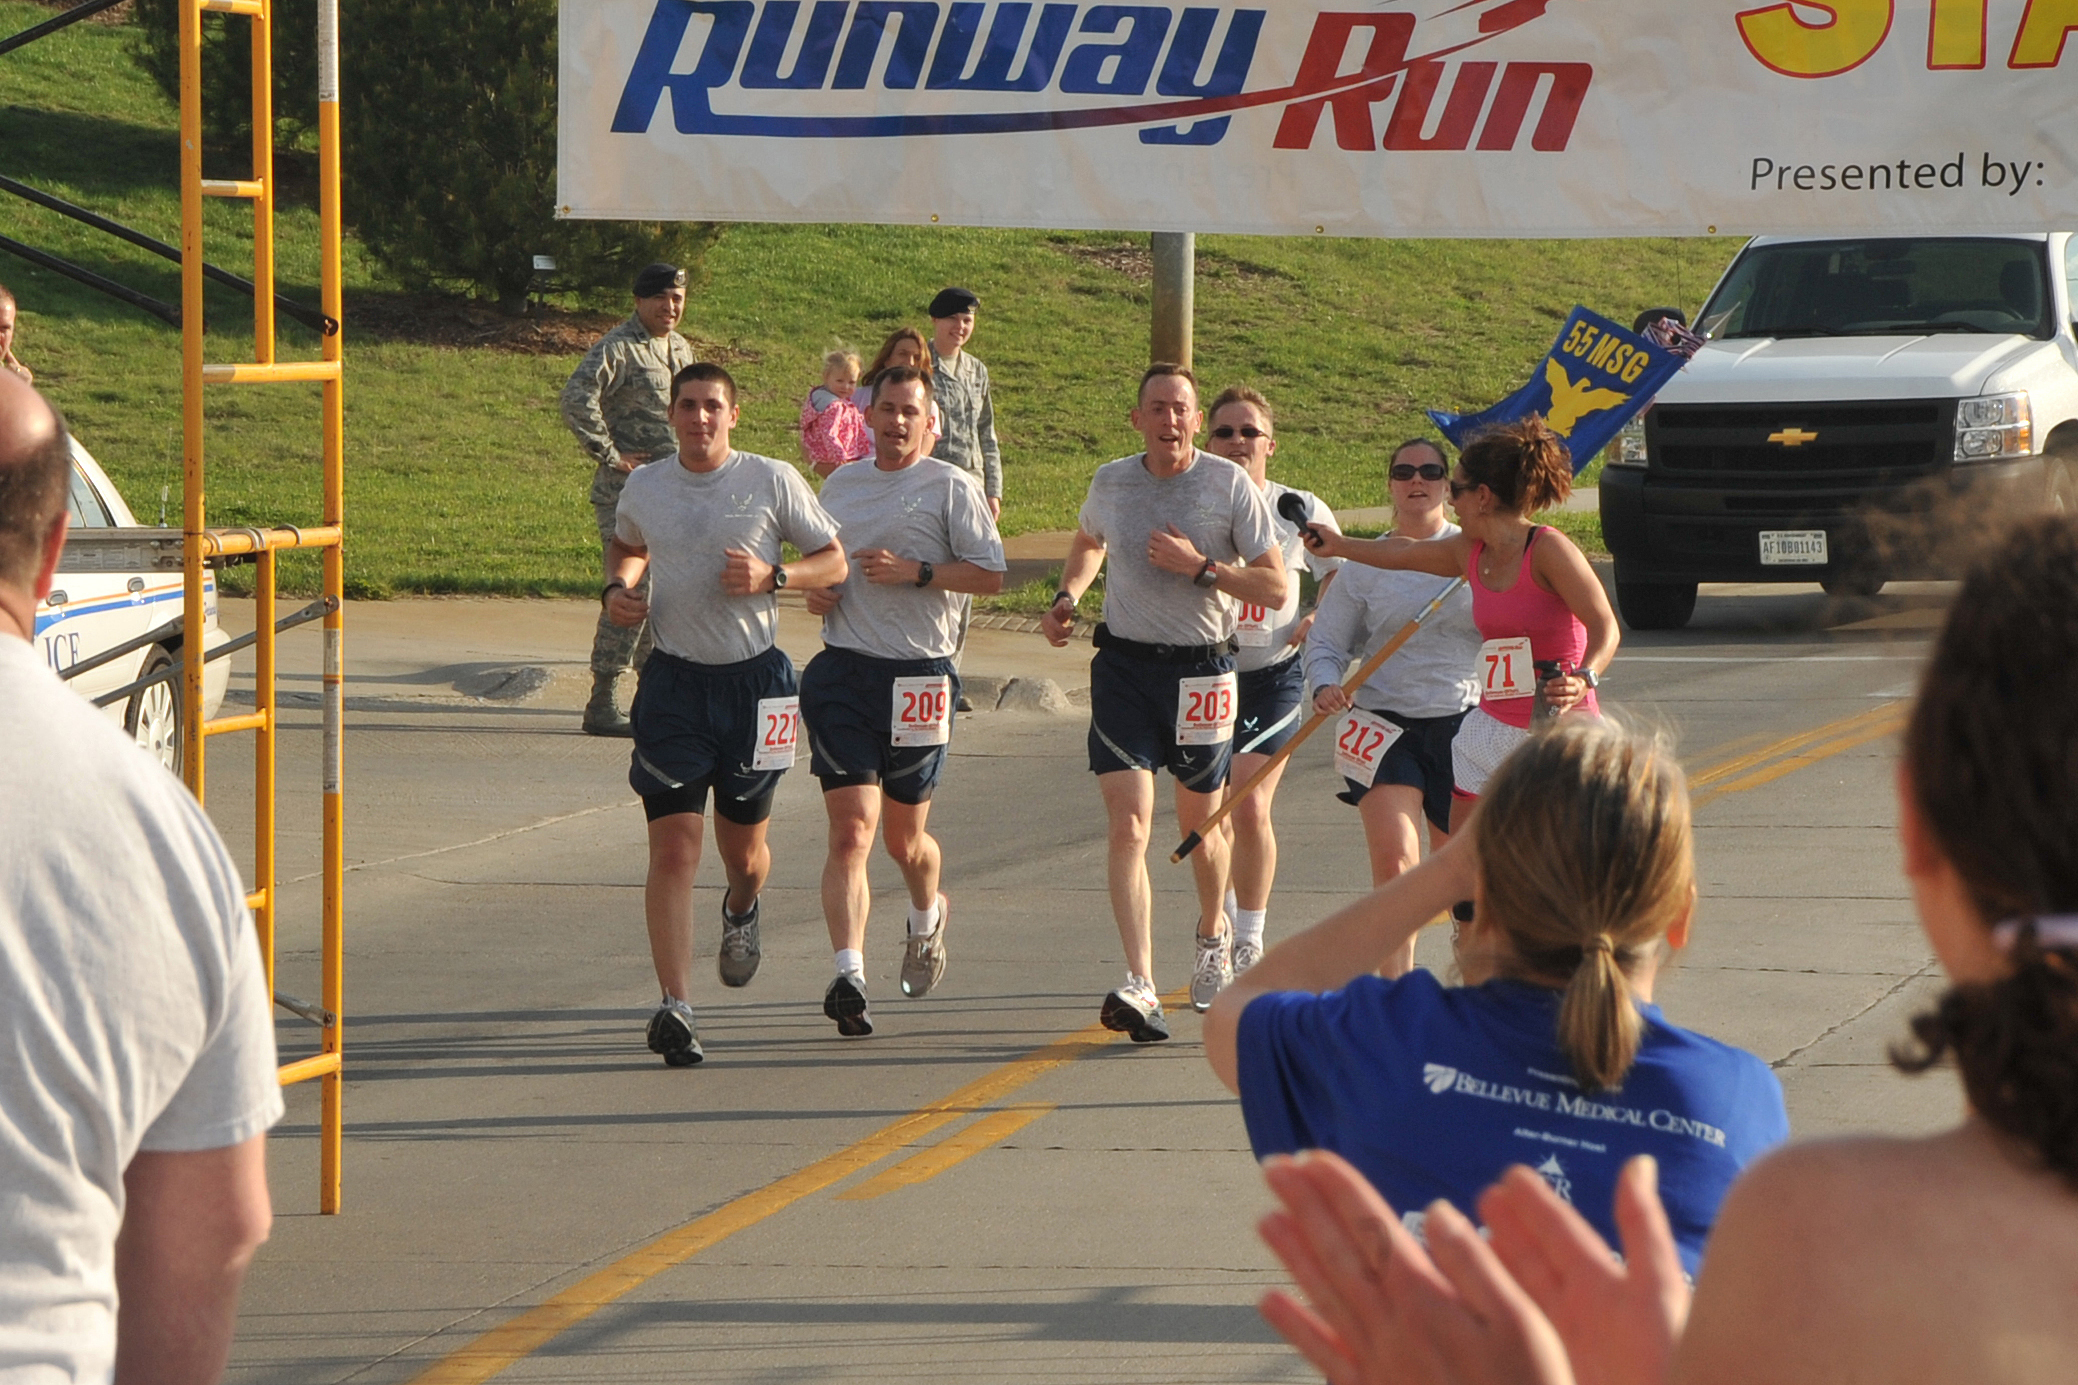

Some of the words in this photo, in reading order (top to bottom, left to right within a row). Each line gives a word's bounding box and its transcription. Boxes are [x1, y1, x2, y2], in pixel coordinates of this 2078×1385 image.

[609, 0, 1262, 146] Runway
[1272, 11, 1593, 152] Run
[1750, 152, 1965, 191] Presented
[1980, 152, 2046, 196] by:
[1562, 319, 1599, 357] 55
[1586, 333, 1650, 384] MSG
[1485, 653, 1515, 689] 71
[901, 691, 946, 722] 209
[1185, 689, 1231, 721] 203
[765, 713, 797, 746] 221
[1339, 719, 1385, 762] 212
[1454, 1071, 1551, 1112] BELLEVUE
[1649, 1108, 1727, 1149] CENTER
